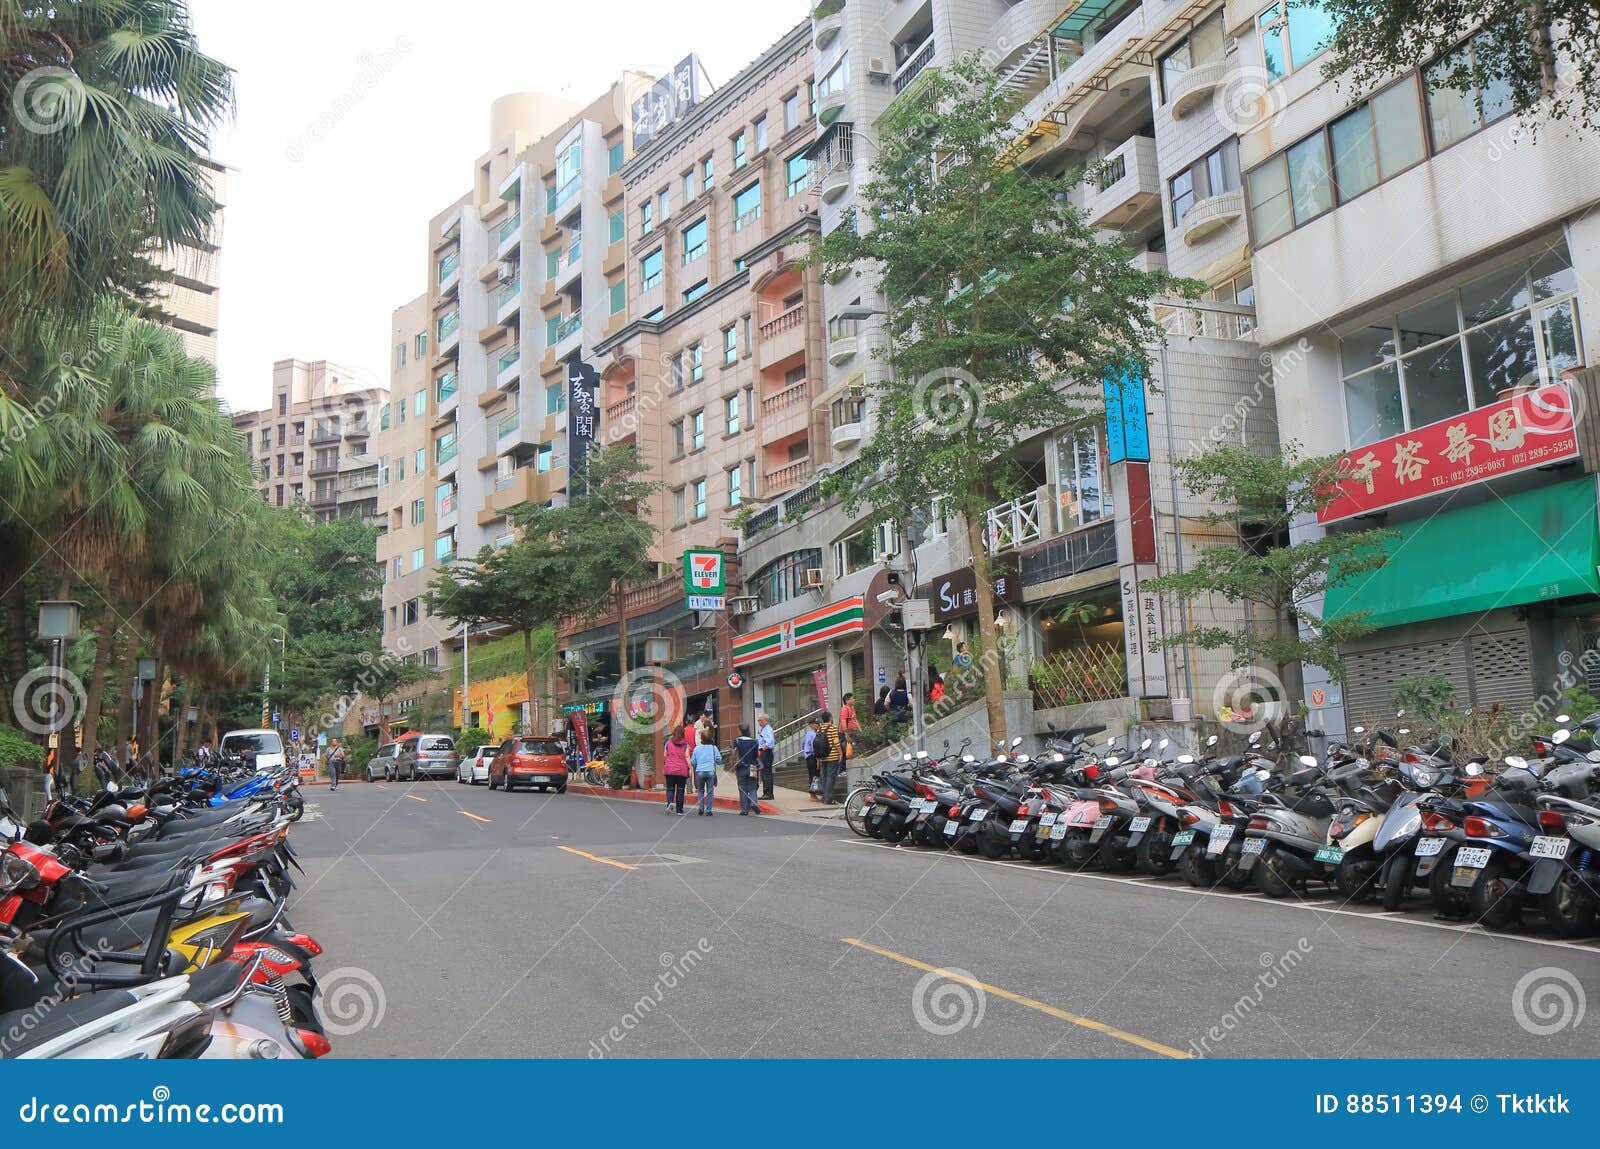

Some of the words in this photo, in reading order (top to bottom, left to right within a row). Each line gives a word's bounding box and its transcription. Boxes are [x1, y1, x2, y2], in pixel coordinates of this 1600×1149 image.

[1431, 475, 1449, 487] TEL:
[1450, 470, 1464, 482] (02)
[1466, 458, 1505, 478] 2895-0087
[1512, 453, 1527, 464] (02)
[1529, 439, 1574, 460] 2895-5250
[940, 581, 960, 613] Su
